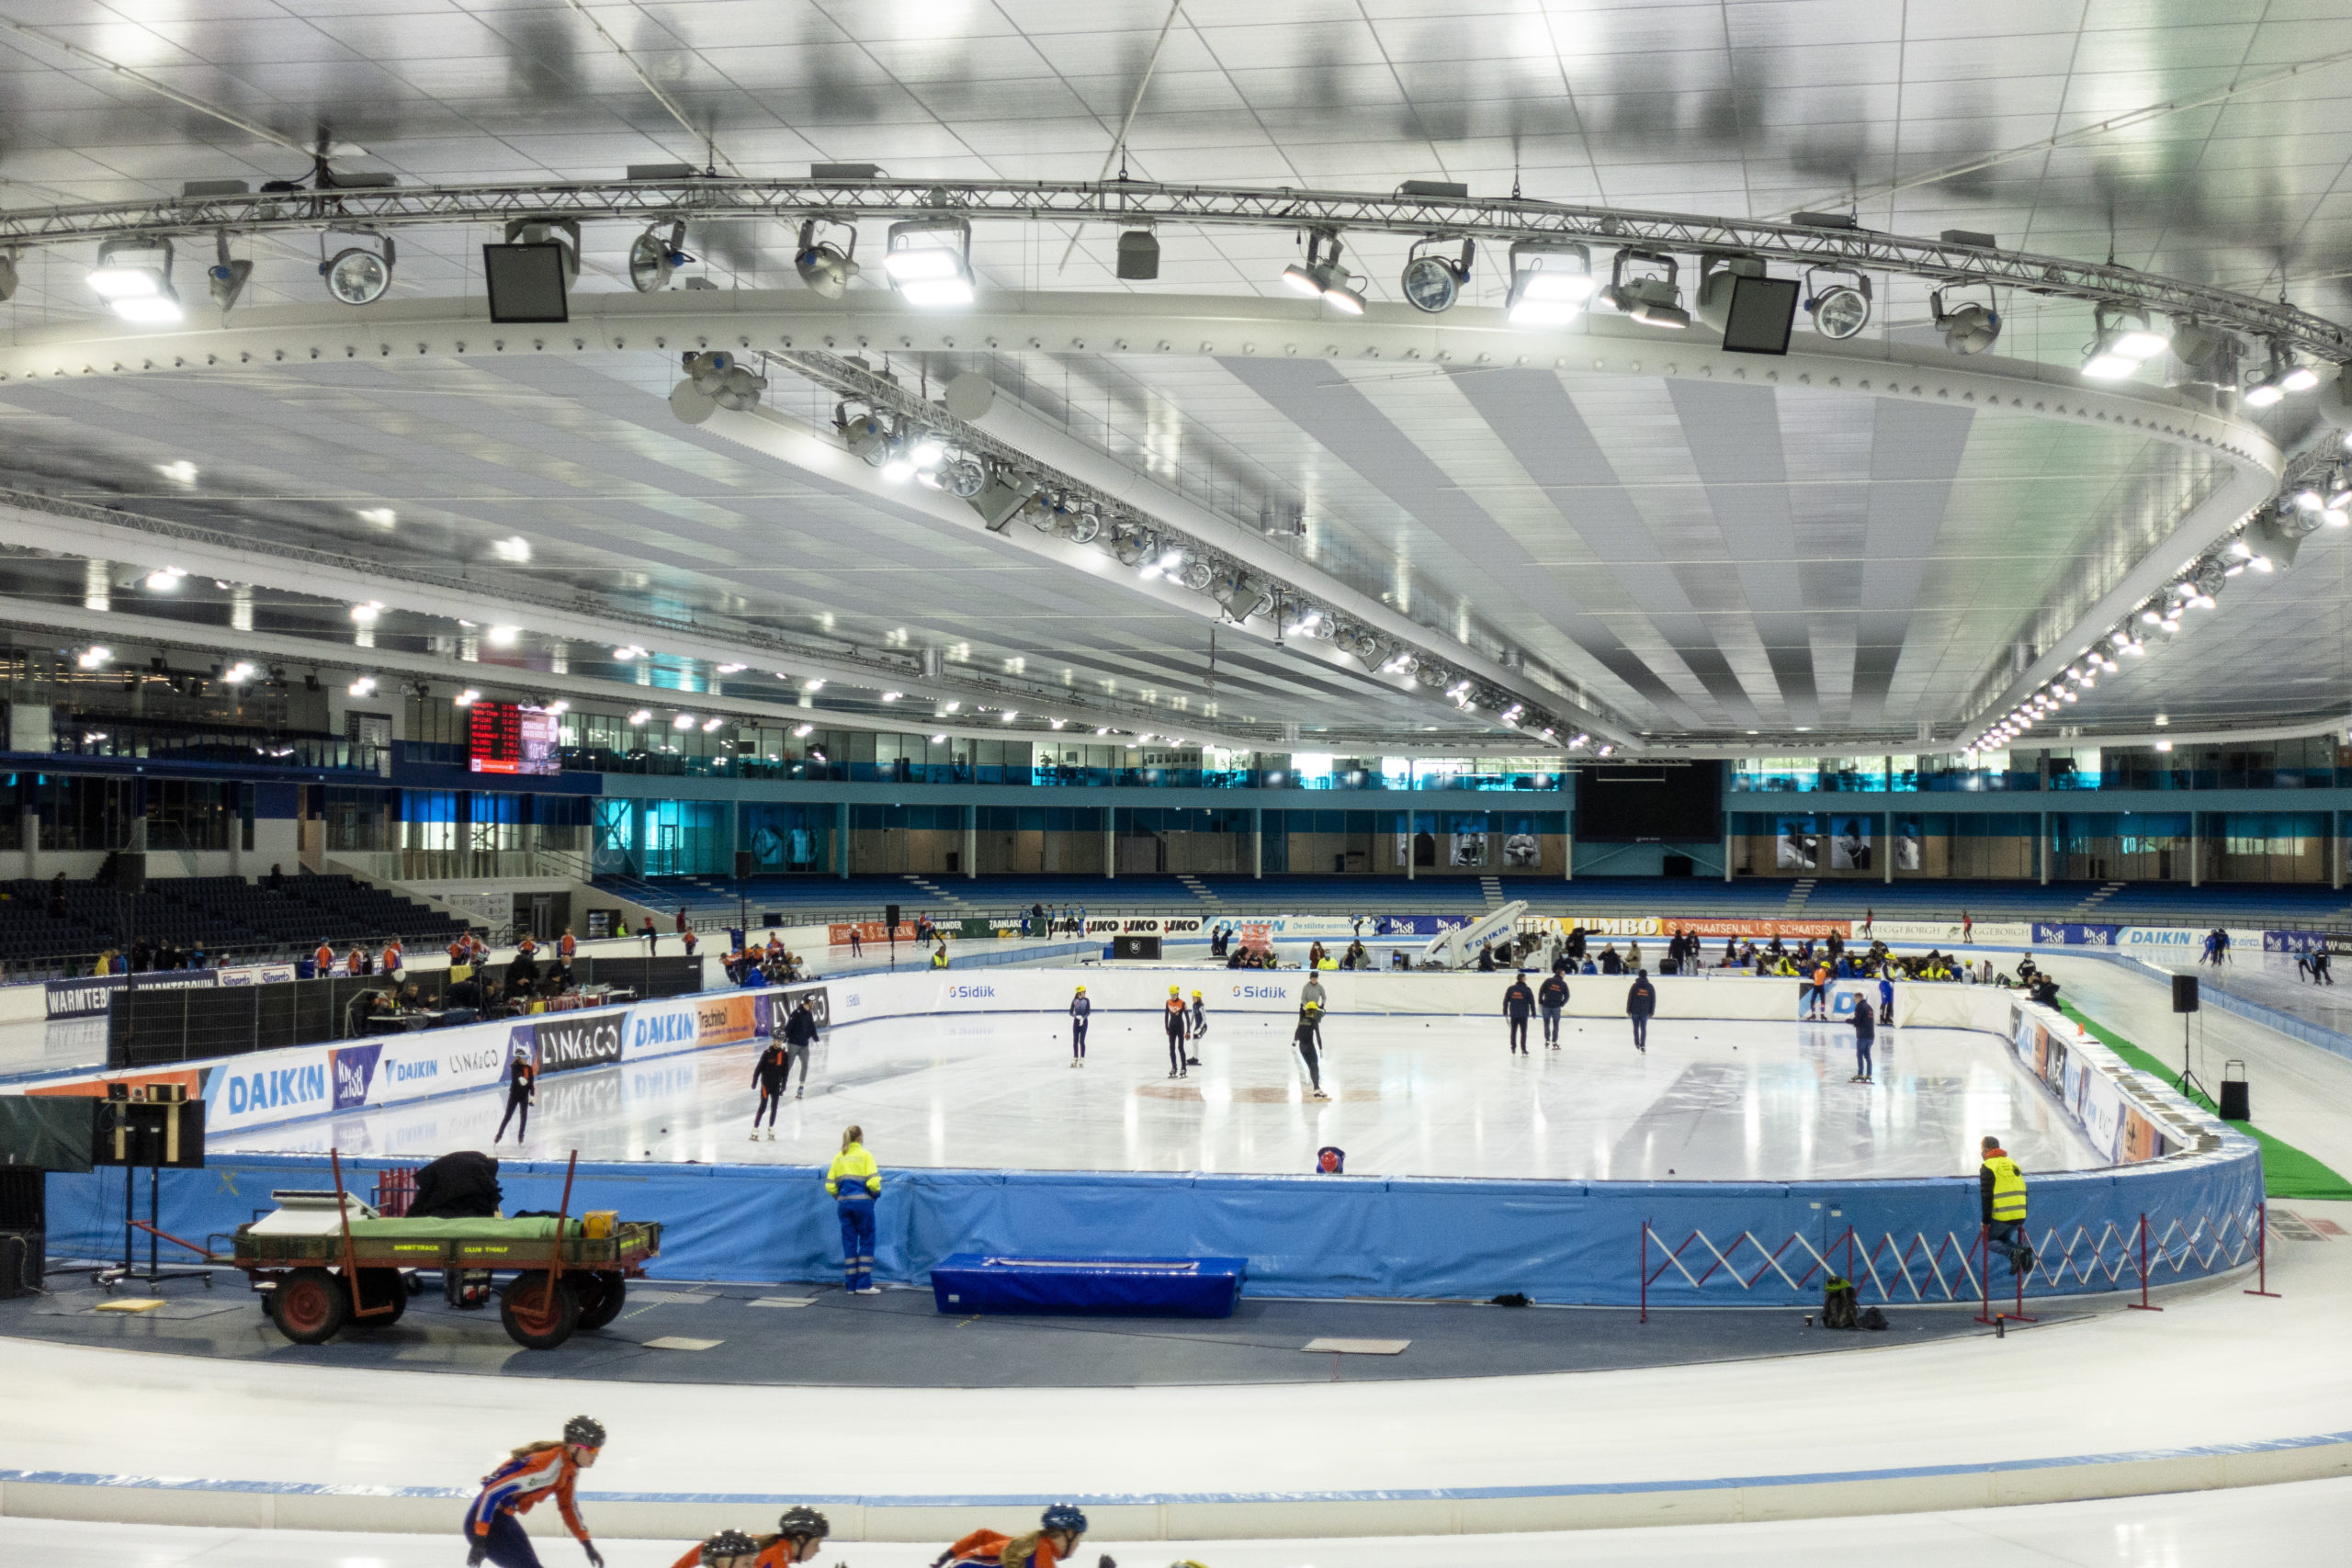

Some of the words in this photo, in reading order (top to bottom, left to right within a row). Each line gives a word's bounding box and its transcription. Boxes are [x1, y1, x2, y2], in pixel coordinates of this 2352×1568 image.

[1475, 925, 1509, 948] DAIKIN
[1684, 922, 1753, 934] SCHAATSEN.NL
[1872, 924, 1940, 935] REGGEBORGH
[2131, 931, 2192, 945] DAIKIN
[958, 986, 995, 998] Sidijk
[1244, 986, 1286, 999] Sidijk
[698, 1006, 729, 1030] Trachitol
[635, 1012, 695, 1047] DAIKIN
[397, 1059, 438, 1081] DAIKIN
[229, 1064, 324, 1115] DAIKIN
